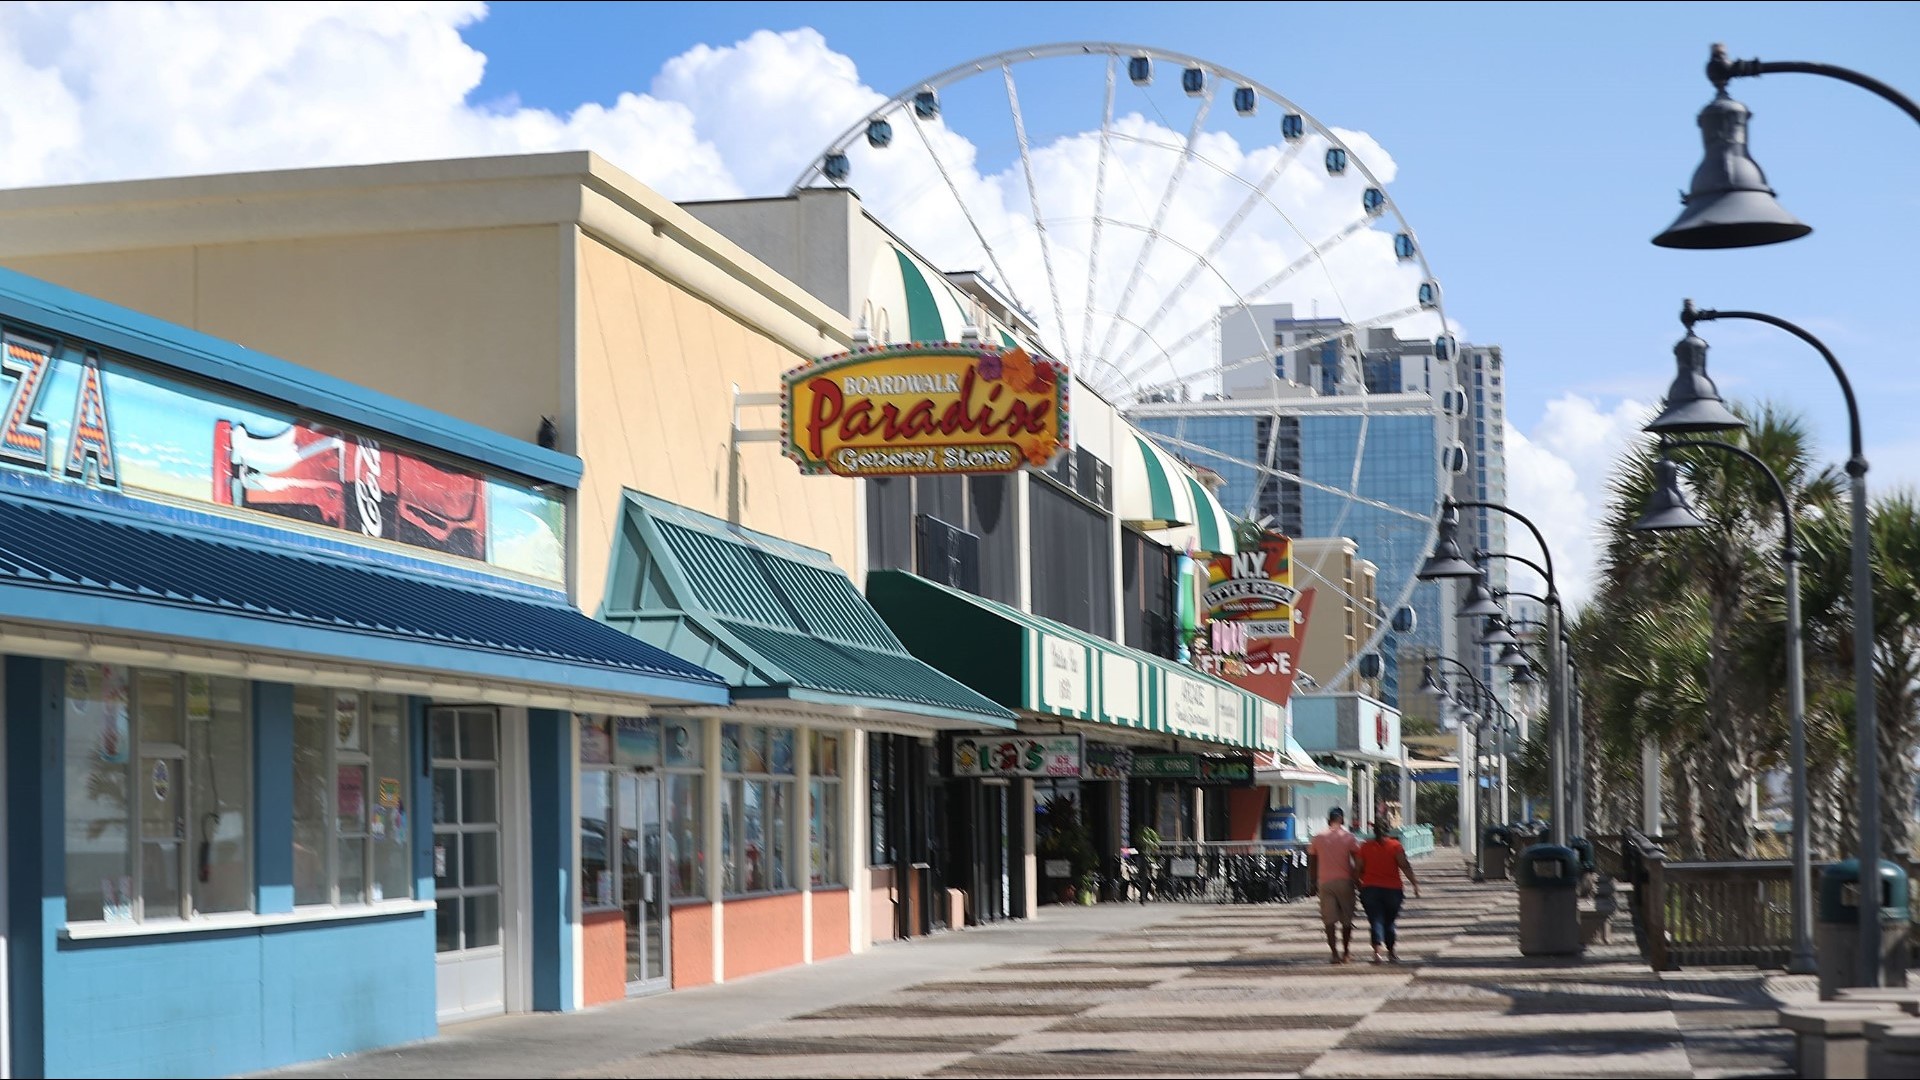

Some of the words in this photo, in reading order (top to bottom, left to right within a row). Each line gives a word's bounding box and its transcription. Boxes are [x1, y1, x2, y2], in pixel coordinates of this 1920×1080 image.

[842, 373, 960, 396] BOARDWALK
[806, 364, 1051, 460] Paradise
[836, 447, 937, 473] General
[943, 447, 1012, 469] Store
[1231, 551, 1270, 580] N.Y.
